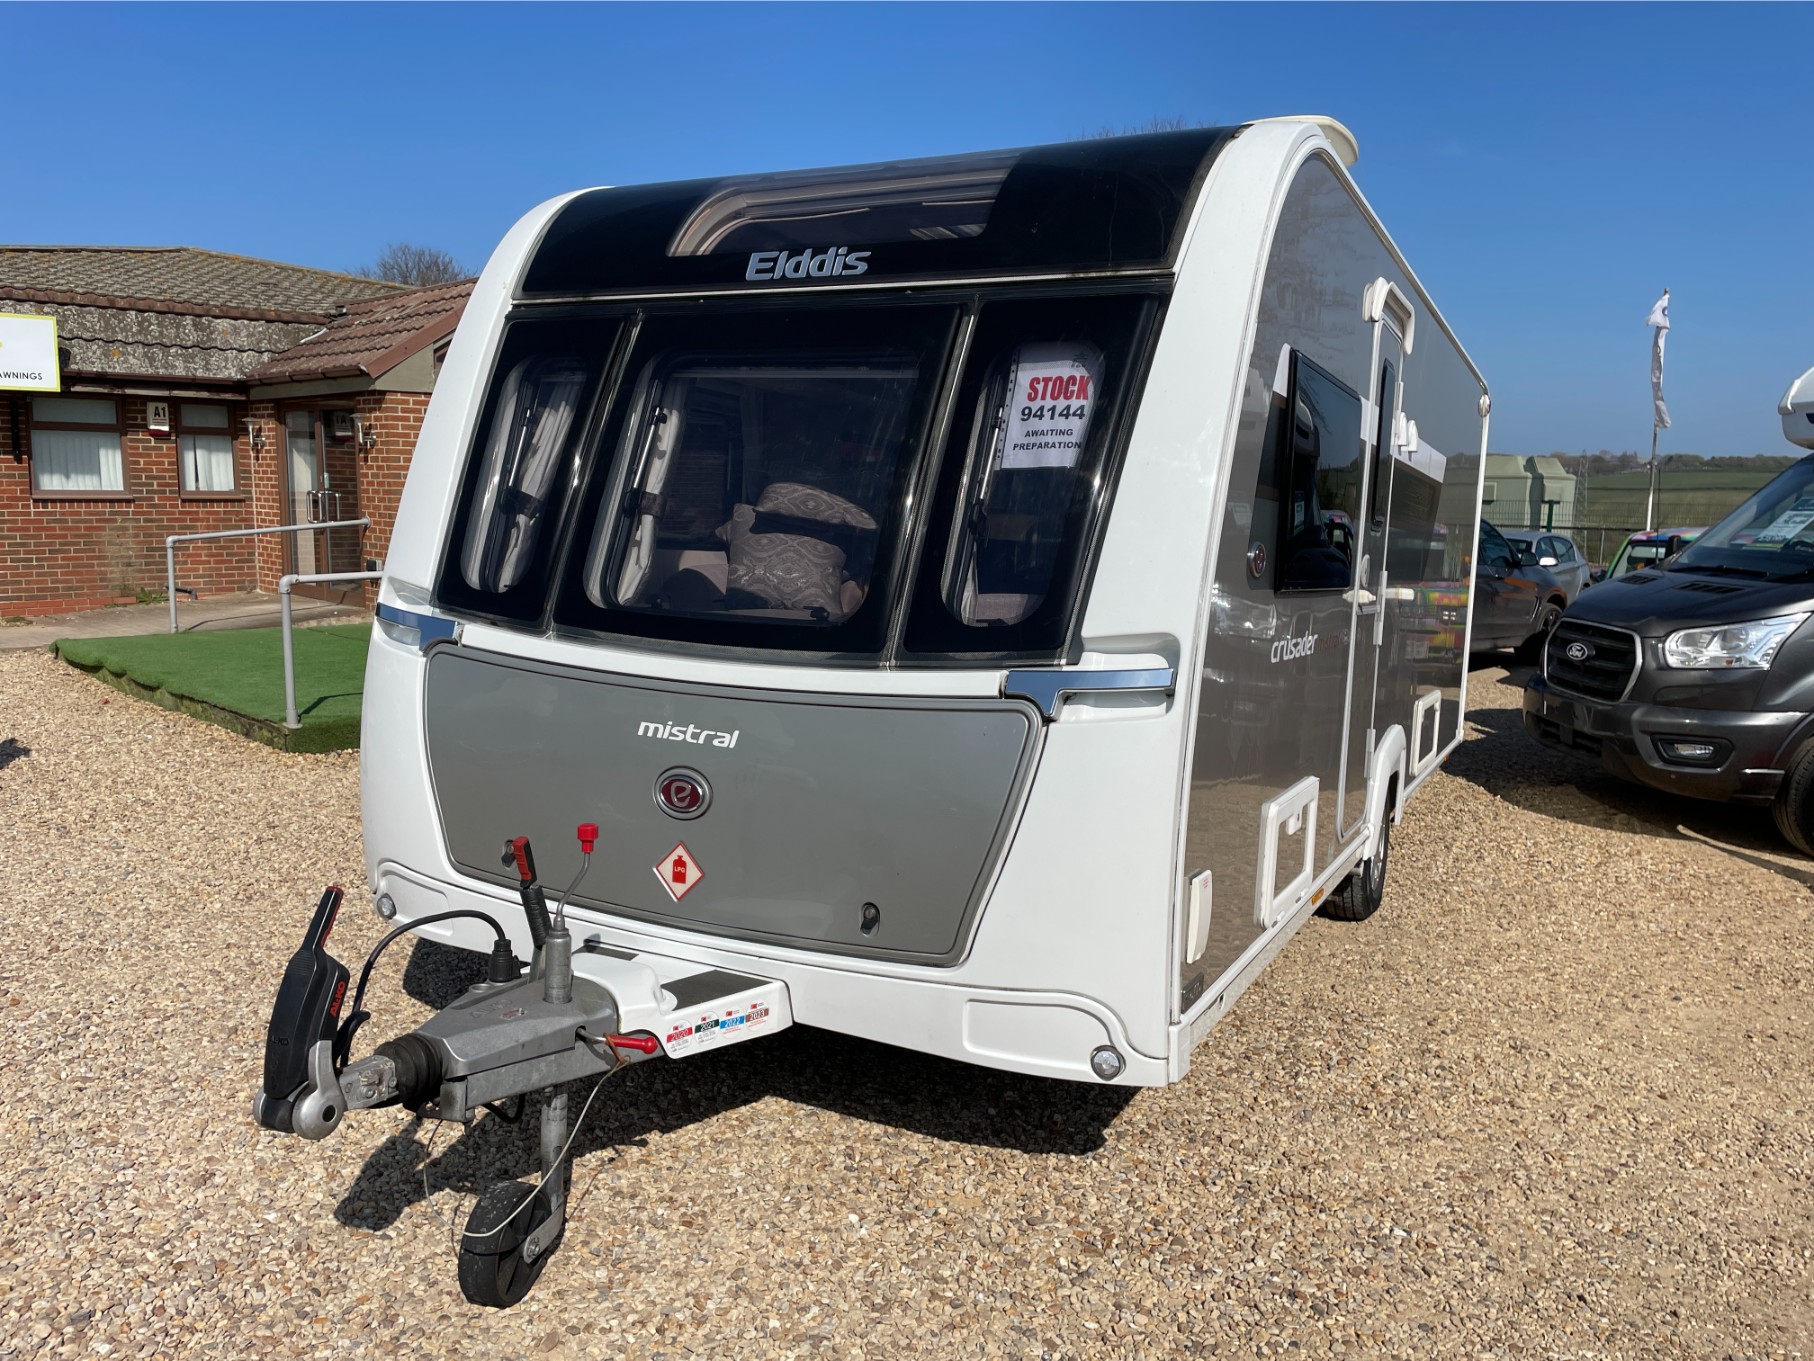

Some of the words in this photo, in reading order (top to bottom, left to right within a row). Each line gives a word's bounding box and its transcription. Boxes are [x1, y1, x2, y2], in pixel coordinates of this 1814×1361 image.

[745, 246, 872, 281] Elddis
[1027, 374, 1093, 402] STOCK
[153, 406, 166, 418] A1
[1020, 404, 1086, 422] 94144
[1024, 428, 1074, 438] AWAITING
[1012, 441, 1082, 451] PREPARATION
[1271, 630, 1319, 664] crusader
[637, 721, 740, 749] mistral
